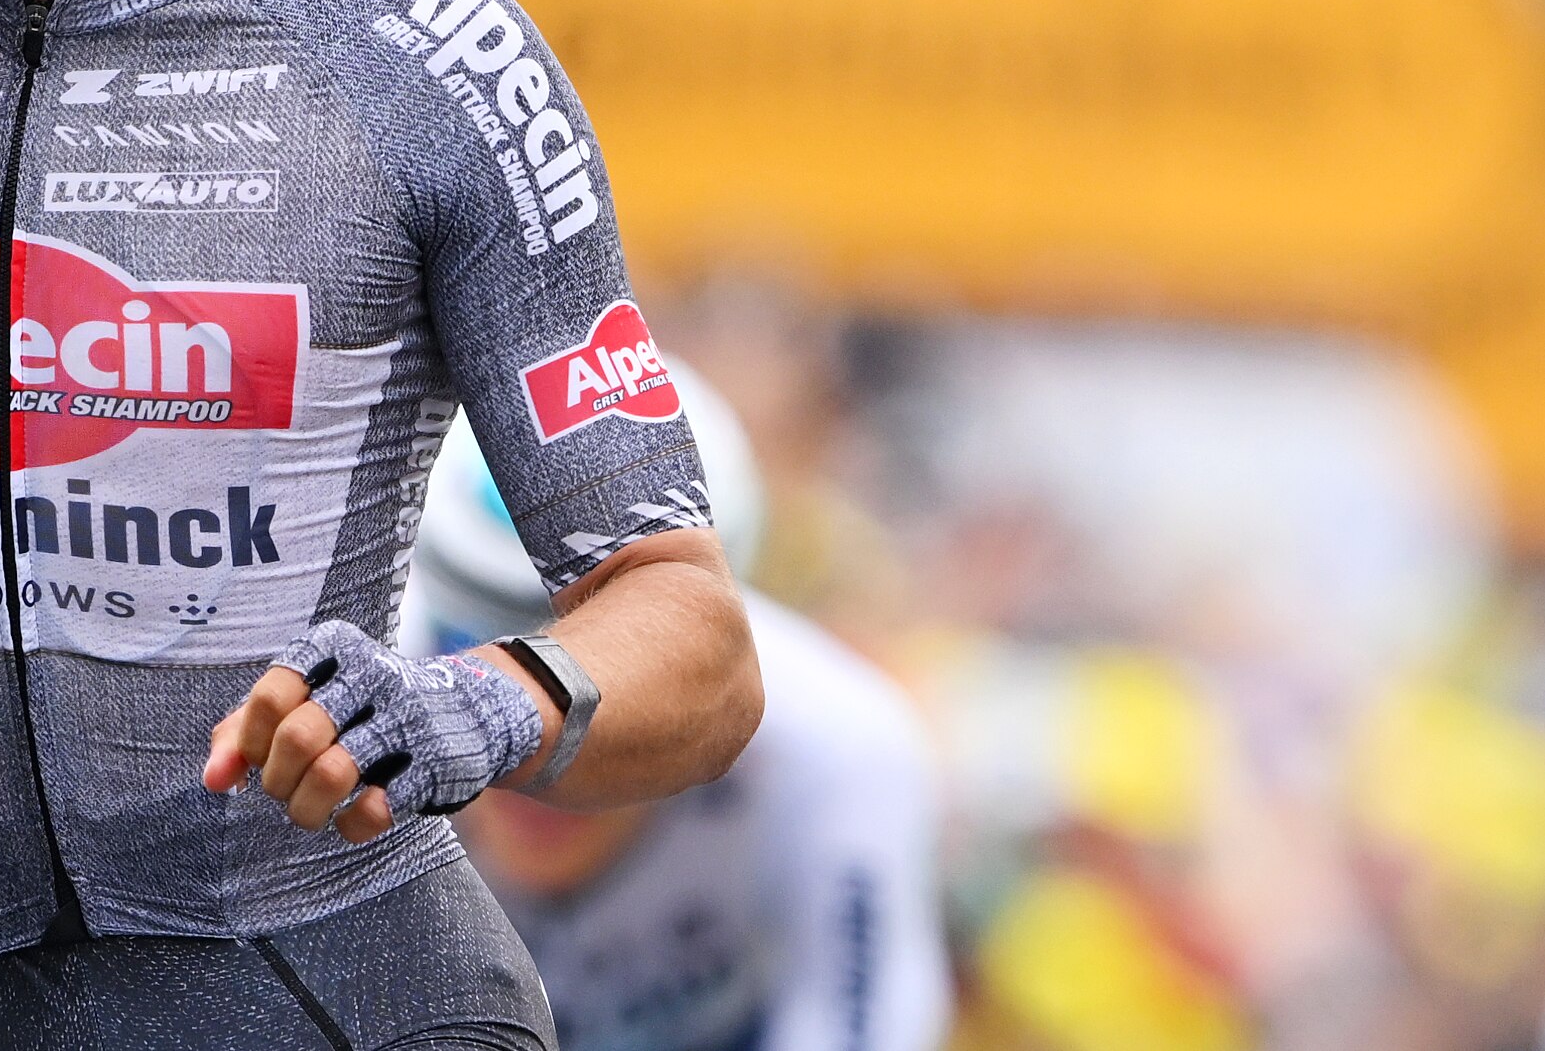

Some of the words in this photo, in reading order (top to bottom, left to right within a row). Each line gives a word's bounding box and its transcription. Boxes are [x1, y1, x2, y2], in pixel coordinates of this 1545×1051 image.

[135, 63, 288, 96] ZWIFT
[54, 121, 282, 147] CANYON
[373, 14, 435, 55] GREY
[442, 73, 509, 148] ATTACK
[496, 148, 549, 256] SHAMPOO
[71, 394, 231, 423] SHAMPOO
[592, 388, 625, 412] GREY
